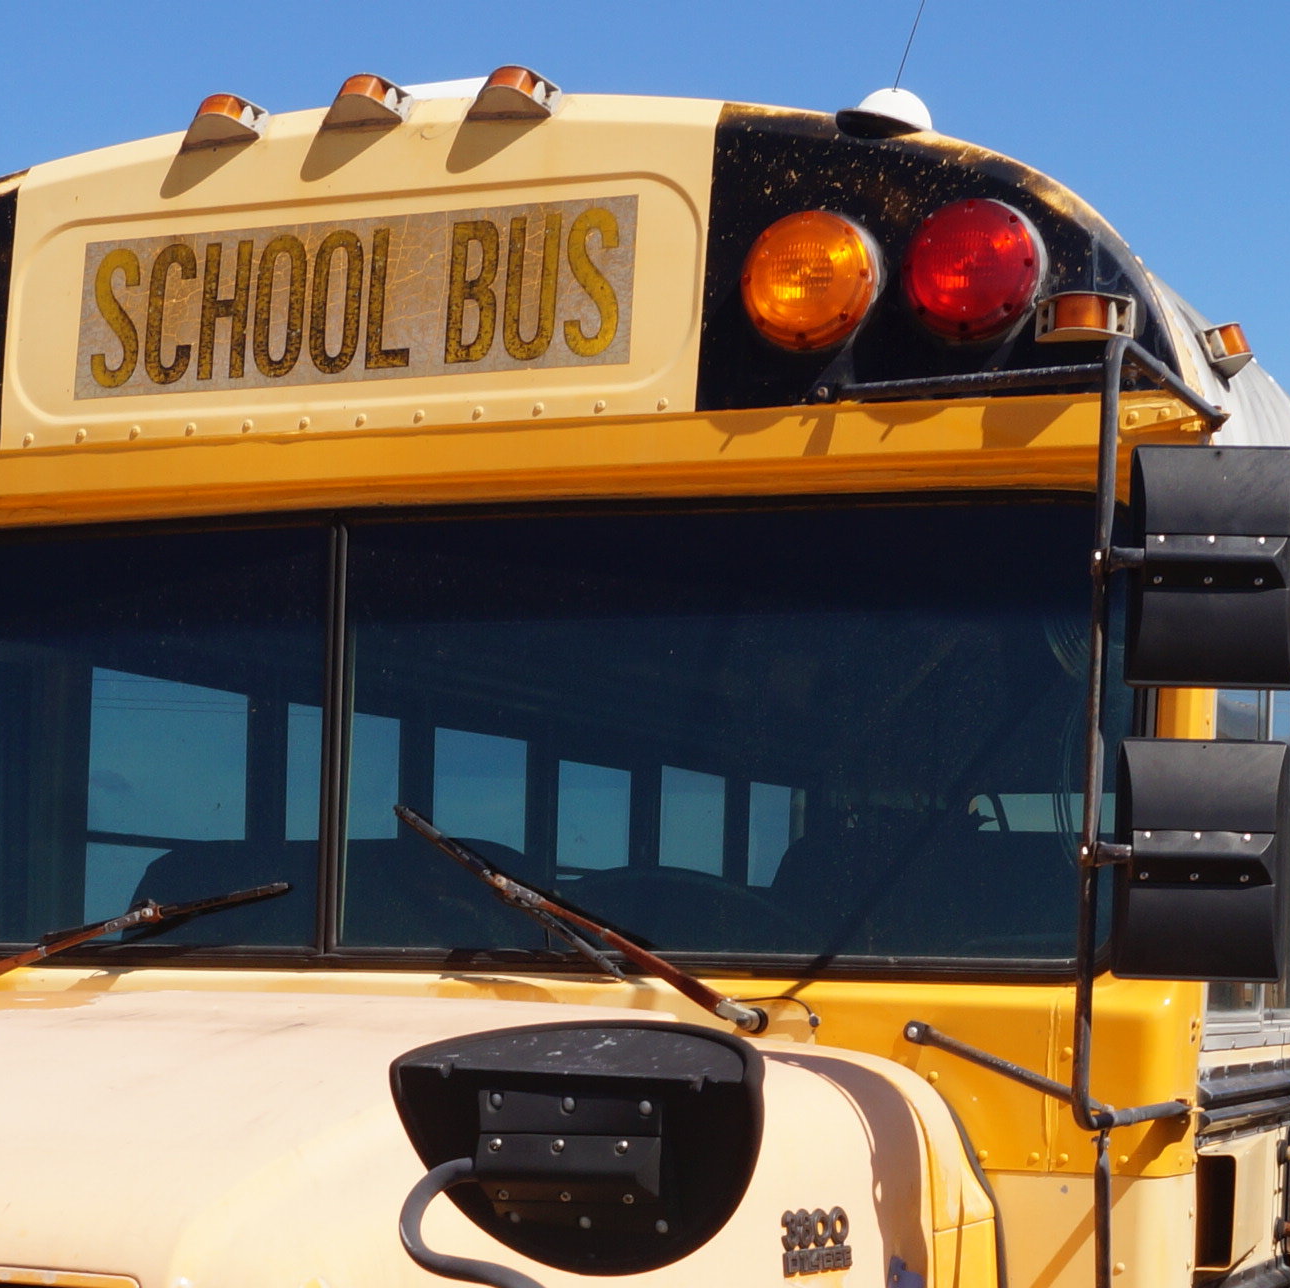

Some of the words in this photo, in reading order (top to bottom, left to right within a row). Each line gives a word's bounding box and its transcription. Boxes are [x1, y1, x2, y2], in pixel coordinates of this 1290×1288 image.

[90, 228, 410, 388] SCHOOL
[444, 208, 620, 365] BUS
[781, 1206, 849, 1251] 3800
